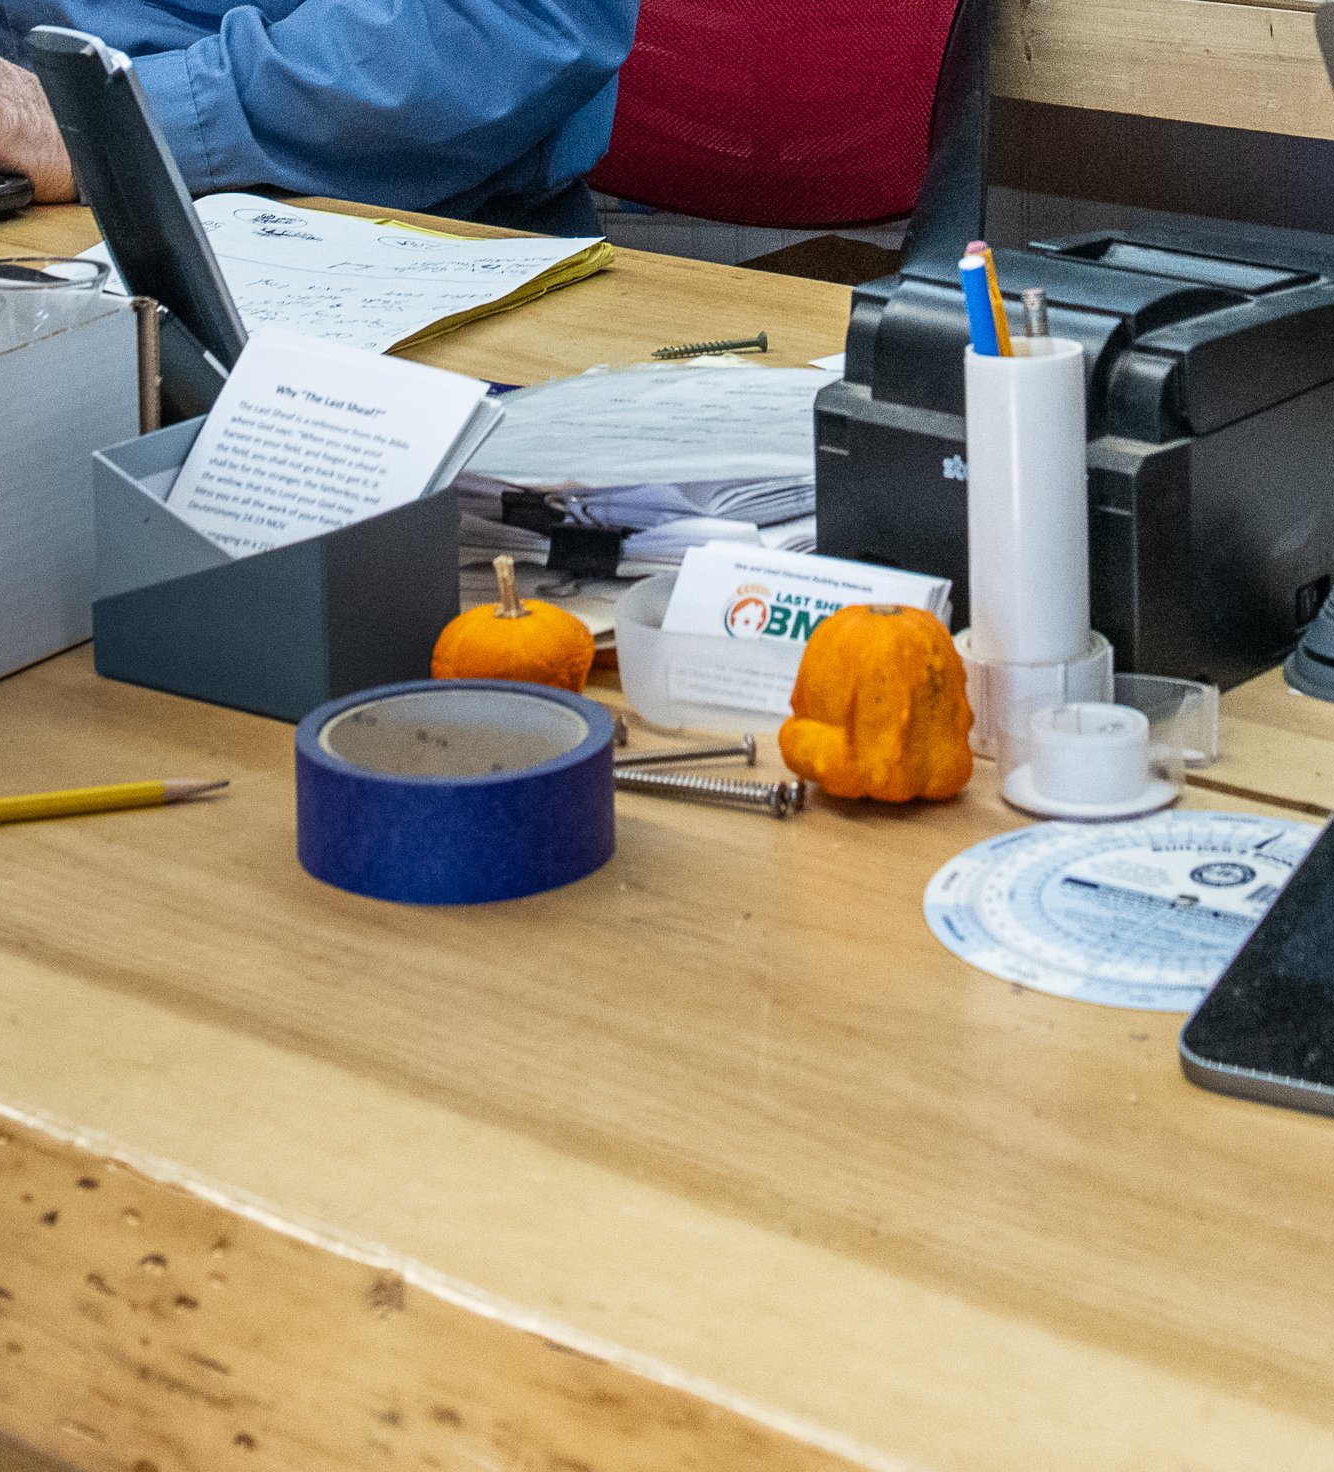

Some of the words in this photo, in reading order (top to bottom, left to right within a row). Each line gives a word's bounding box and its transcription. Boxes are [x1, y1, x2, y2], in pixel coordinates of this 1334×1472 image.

[775, 591, 811, 608] LAST
[813, 597, 844, 611] SHE
[762, 604, 825, 642] BM
